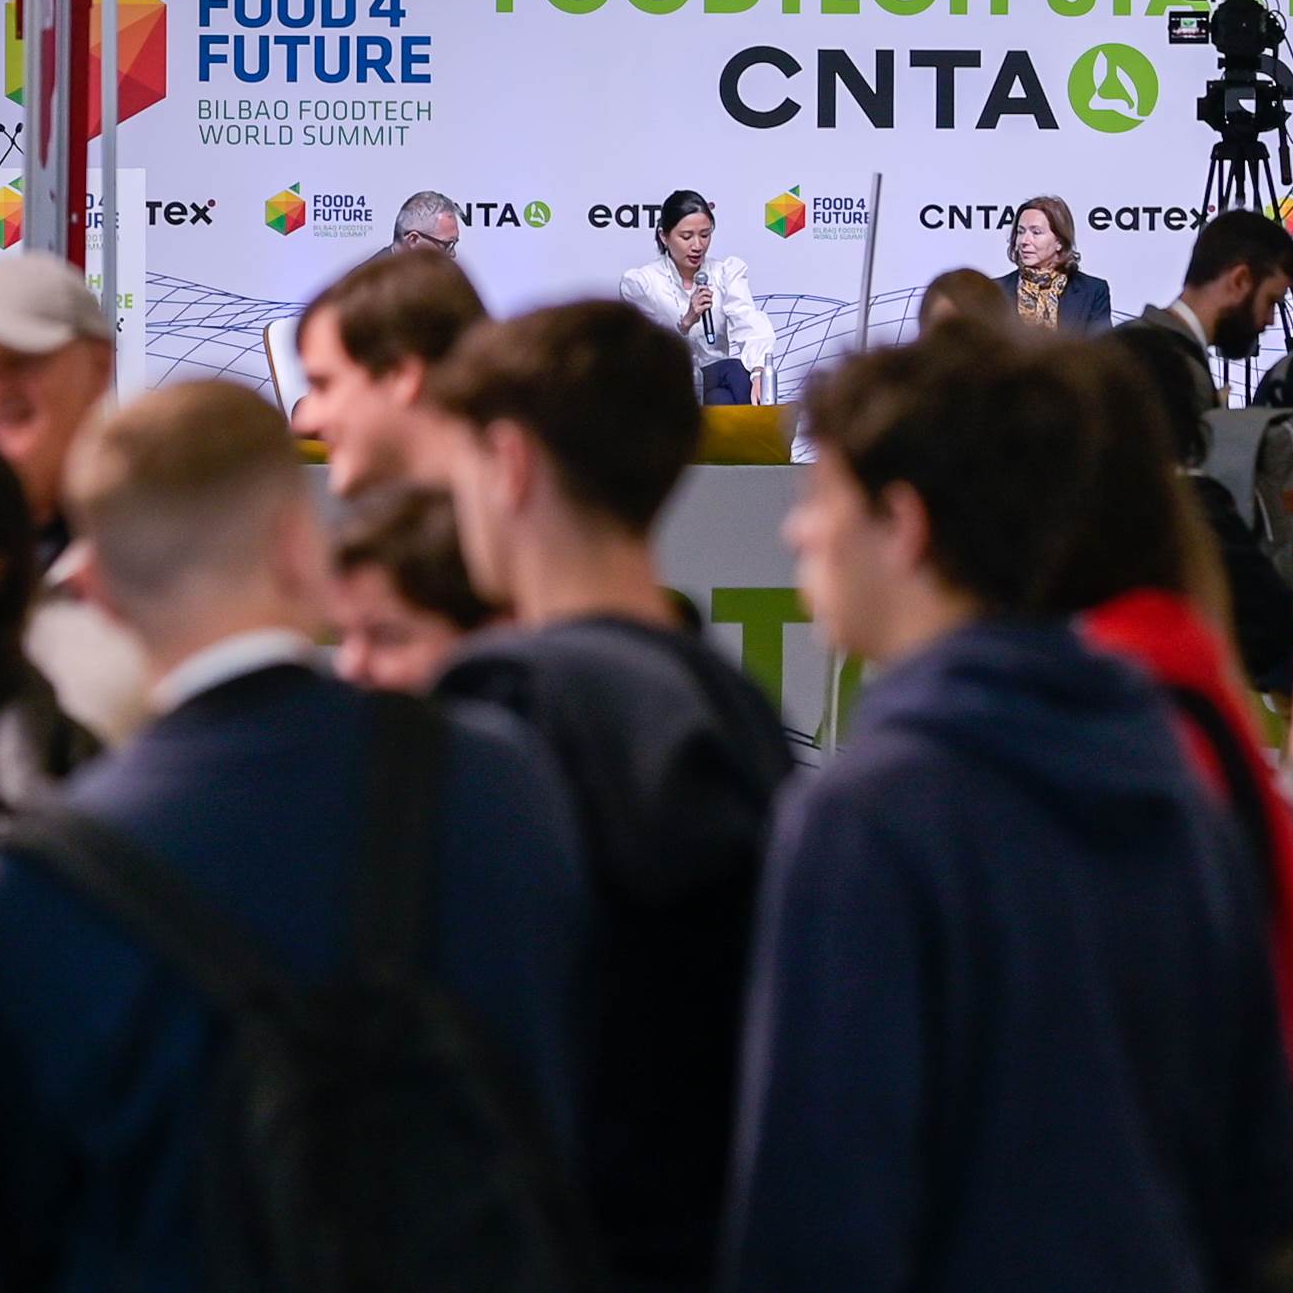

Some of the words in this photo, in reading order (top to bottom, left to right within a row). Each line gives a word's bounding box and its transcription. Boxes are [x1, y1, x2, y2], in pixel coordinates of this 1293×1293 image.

[197, 34, 433, 84] FUTURE
[718, 44, 1060, 130] CNTA
[197, 99, 290, 122] BILBAO
[298, 99, 433, 123] FOODTECH
[197, 124, 294, 146] WORLD
[302, 124, 410, 146] SUMMIT
[313, 194, 354, 208] FOOD
[356, 195, 366, 208] 4
[813, 197, 854, 211] FOOD
[856, 198, 866, 210] 4
[313, 208, 373, 222] FUTURE
[454, 201, 521, 228] NTA
